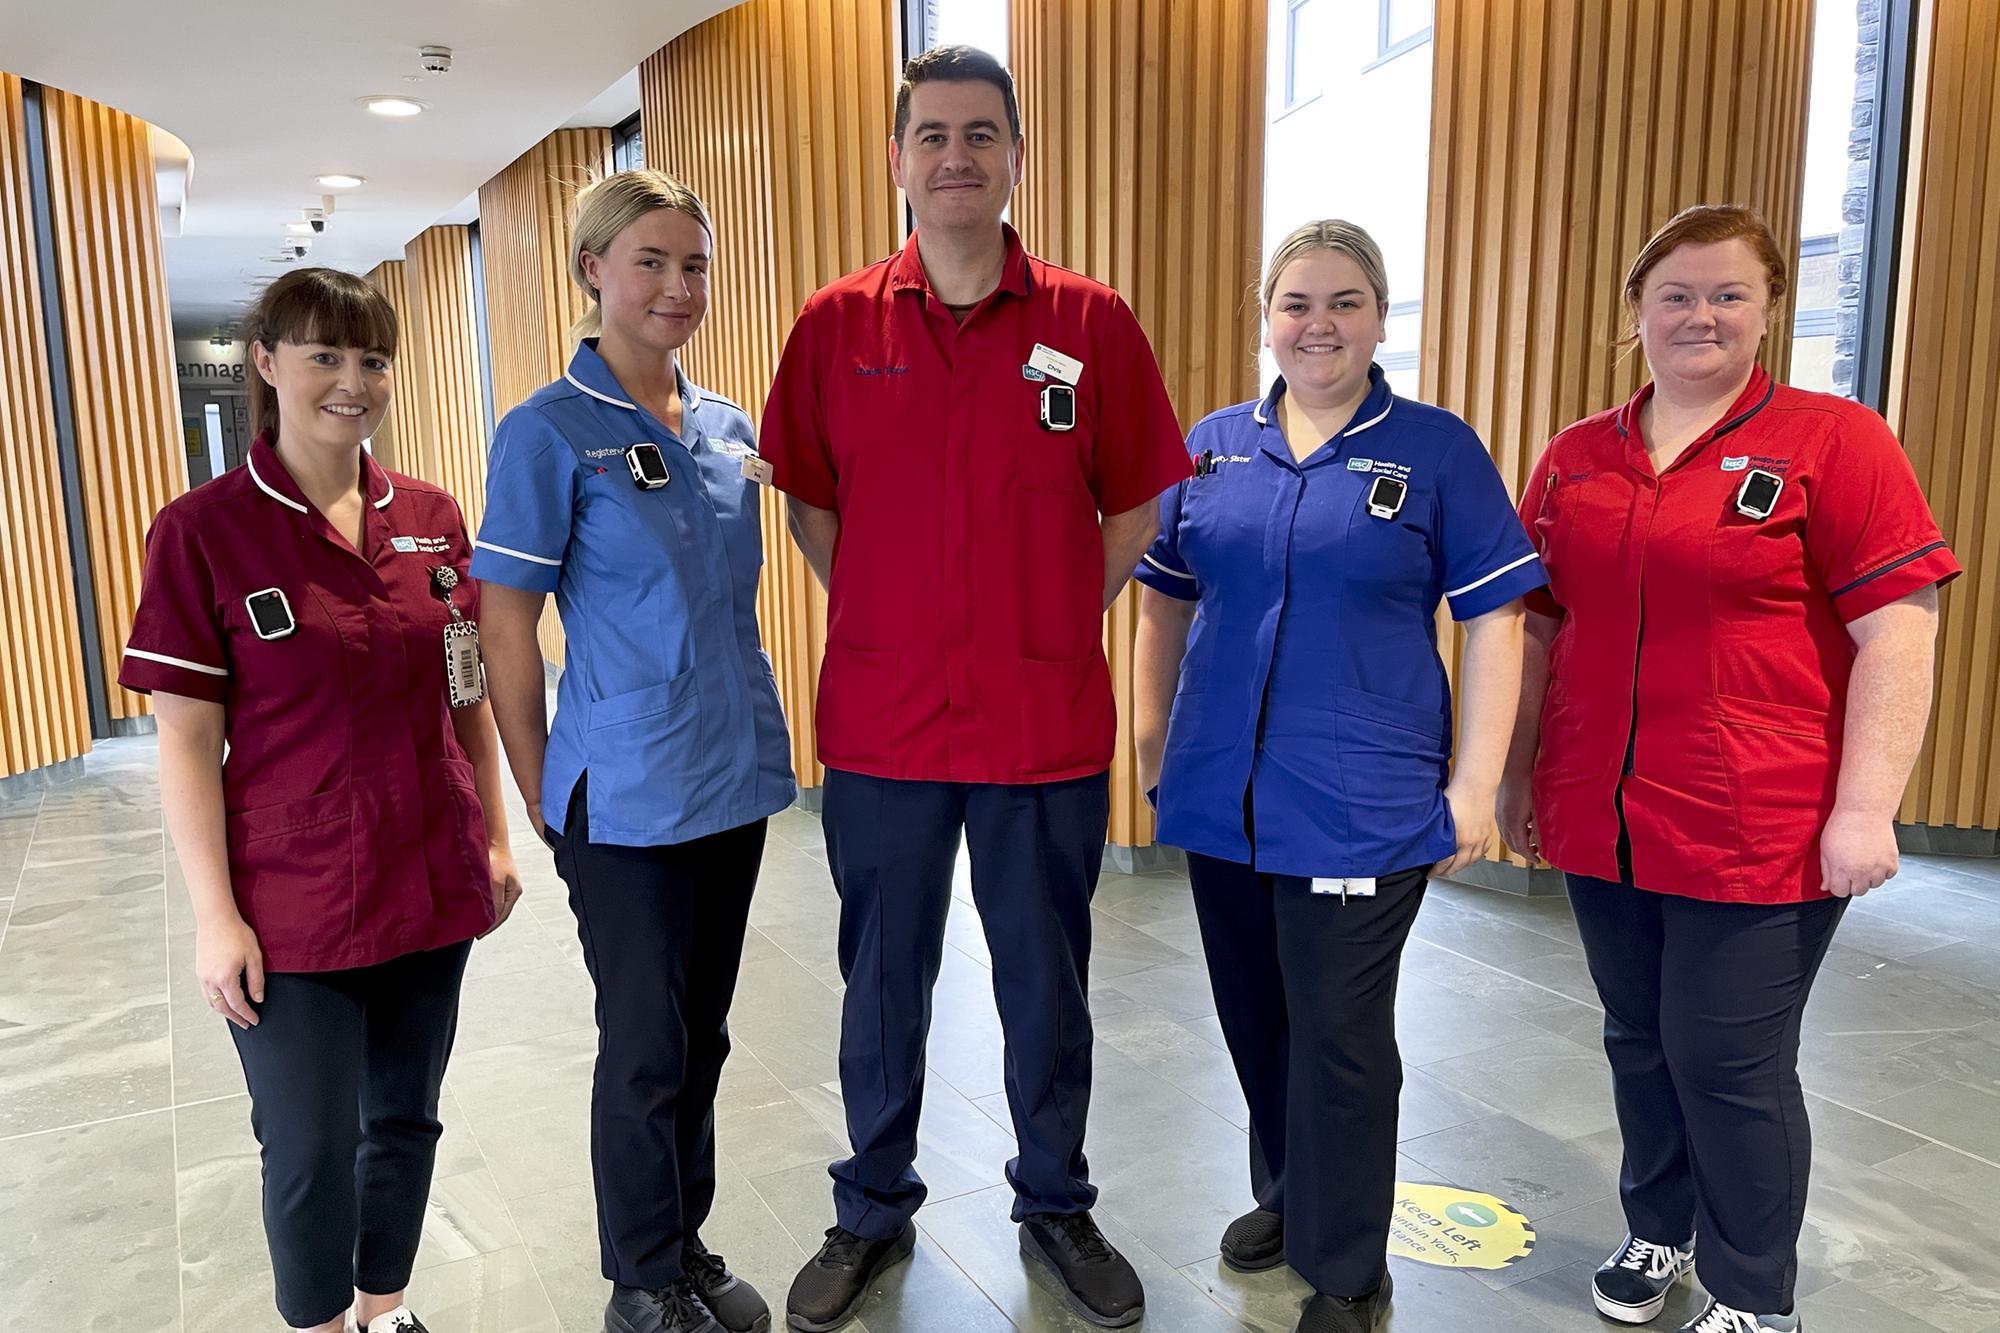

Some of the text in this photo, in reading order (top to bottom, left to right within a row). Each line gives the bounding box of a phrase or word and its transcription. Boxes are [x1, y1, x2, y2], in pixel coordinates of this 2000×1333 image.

[1047, 363, 1062, 374] Chris
[1374, 460, 1411, 473] Health and
[1371, 467, 1408, 480] Social Care
[433, 544, 450, 553] Care
[1396, 1199, 1482, 1252] Keep Left
[1393, 1214, 1460, 1261] intain Your
